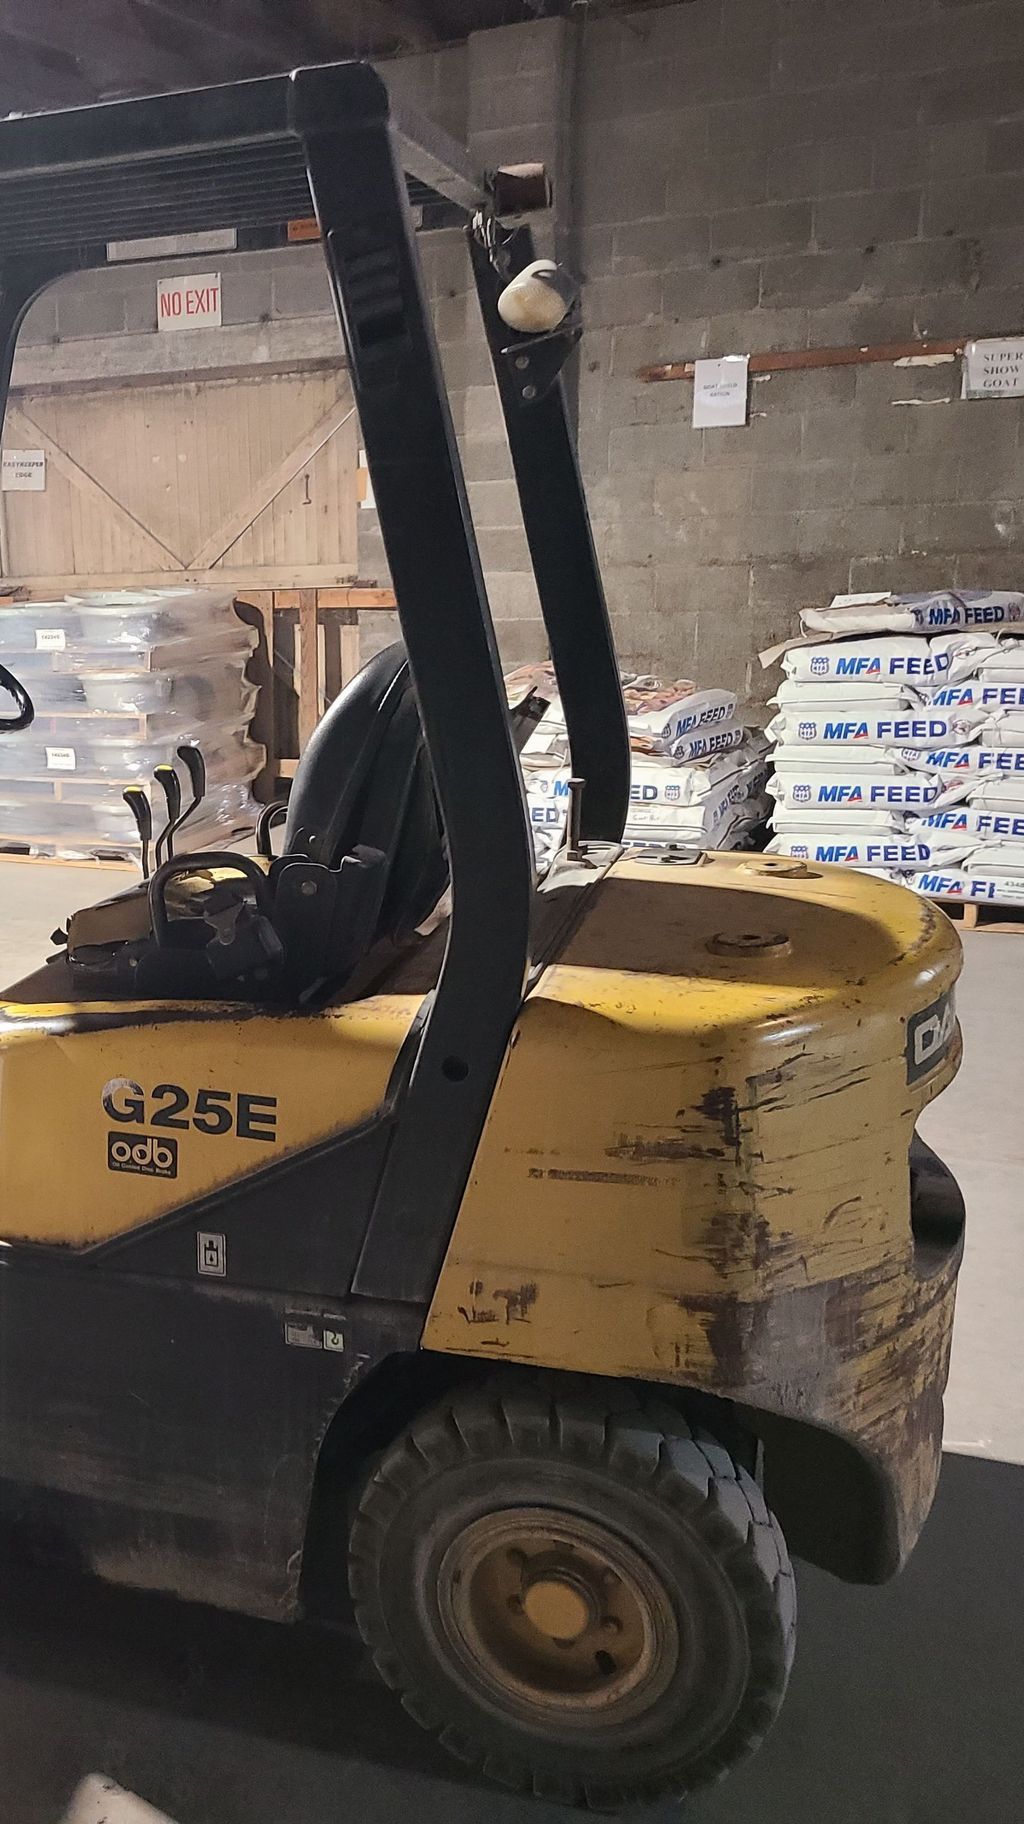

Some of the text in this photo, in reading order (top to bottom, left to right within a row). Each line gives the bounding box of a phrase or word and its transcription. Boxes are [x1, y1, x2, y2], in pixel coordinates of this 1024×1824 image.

[160, 288, 219, 317] NO EXIT
[983, 365, 1019, 375] SHOW
[983, 378, 1018, 388] GOAT
[928, 605, 1005, 625] MFA FEED
[835, 657, 881, 676] MFA
[889, 652, 950, 675] FEED
[676, 706, 726, 736] MFA FEED
[823, 722, 869, 740] MFA
[877, 720, 947, 739] FEED
[689, 733, 734, 758] MFA FEED
[926, 752, 970, 769] MFA
[818, 785, 863, 805] MFA
[870, 786, 938, 803] FEED
[922, 812, 967, 830] MFA
[815, 846, 859, 863] MFA
[867, 844, 931, 862] FEED
[918, 874, 962, 895] MFA
[102, 1078, 277, 1142] G25E
[111, 1138, 173, 1168] odb
